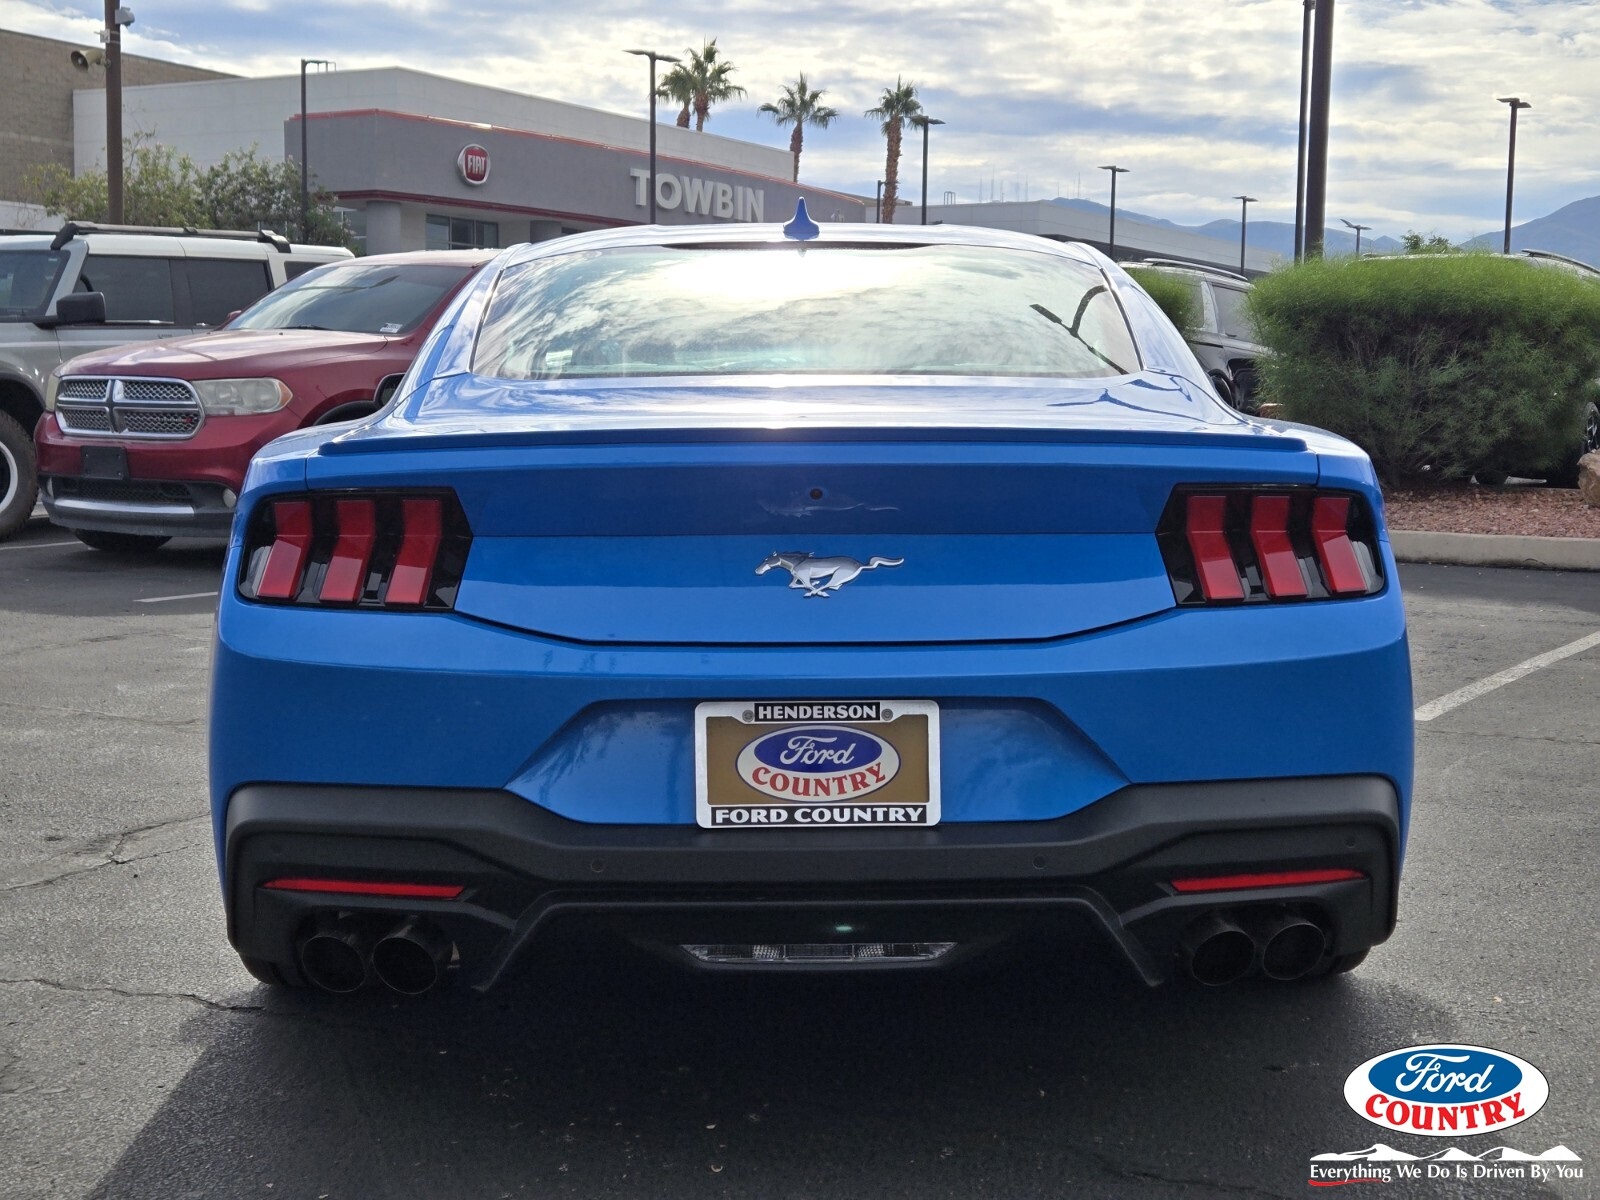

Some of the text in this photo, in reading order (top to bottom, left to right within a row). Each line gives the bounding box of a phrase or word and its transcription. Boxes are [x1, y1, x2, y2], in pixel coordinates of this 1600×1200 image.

[467, 154, 486, 175] FIAT
[630, 167, 764, 222] TOWBIN
[758, 705, 876, 719] HENDERSON
[779, 735, 857, 765] Ford
[752, 762, 886, 797] COUNTRY
[715, 807, 923, 823] FORD COUNTRY
